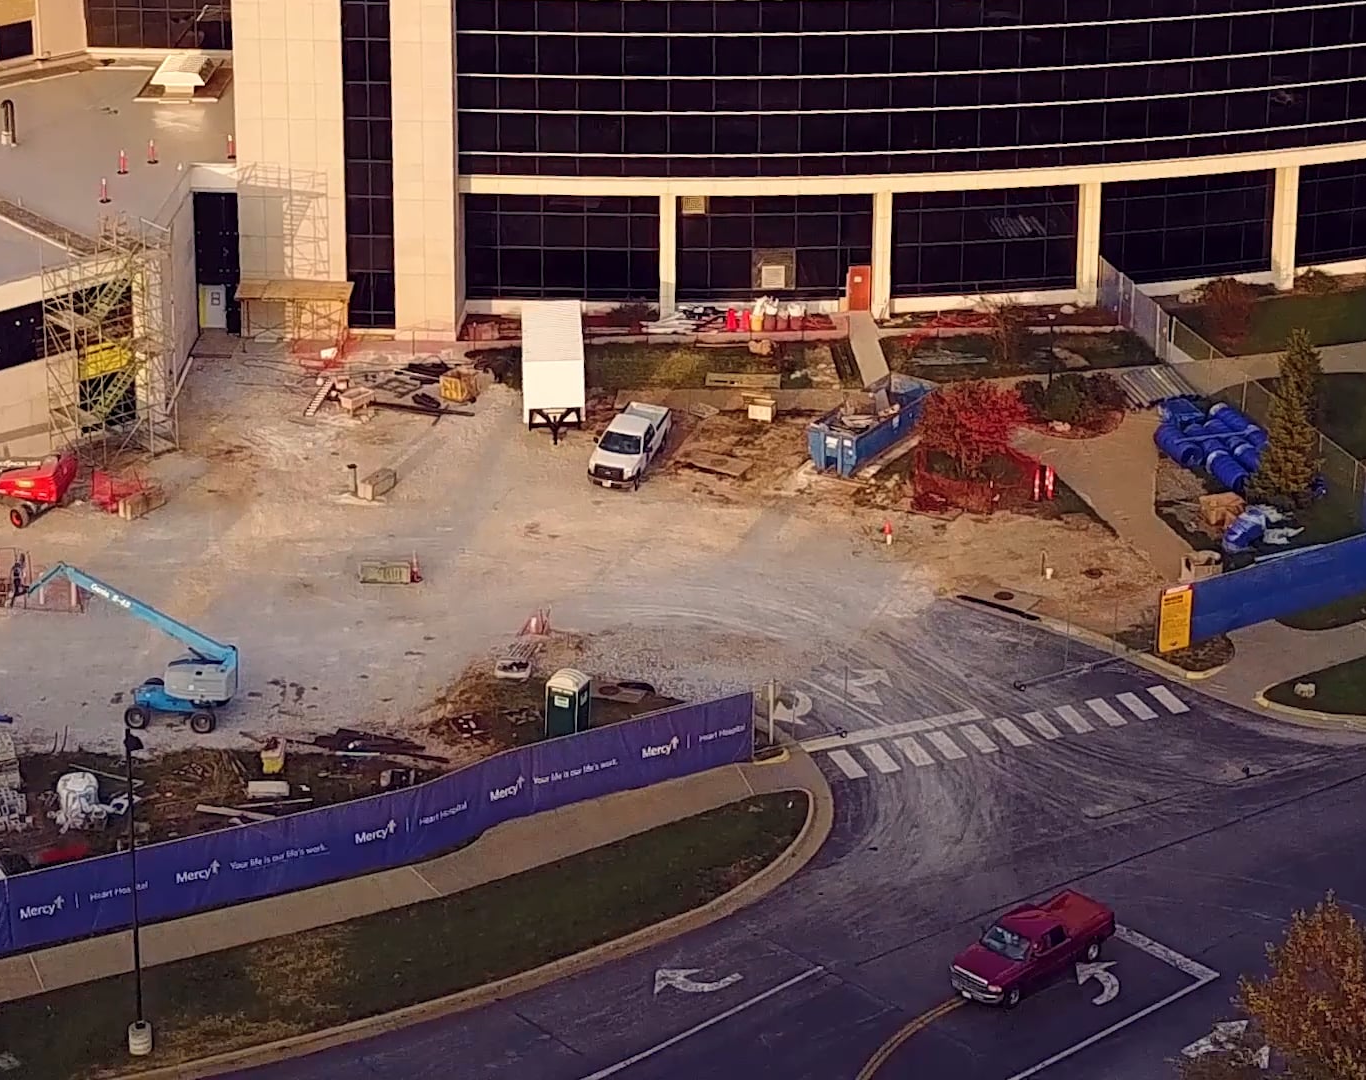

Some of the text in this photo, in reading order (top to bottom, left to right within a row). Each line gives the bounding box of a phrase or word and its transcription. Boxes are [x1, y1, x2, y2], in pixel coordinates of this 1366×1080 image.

[641, 743, 672, 759] Mercy
[489, 782, 520, 801] Mercy
[354, 827, 389, 845] Mercy
[229, 861, 249, 871] Your
[175, 867, 211, 884] Mercy
[89, 888, 114, 902] Heart
[18, 903, 56, 920] Mercy
